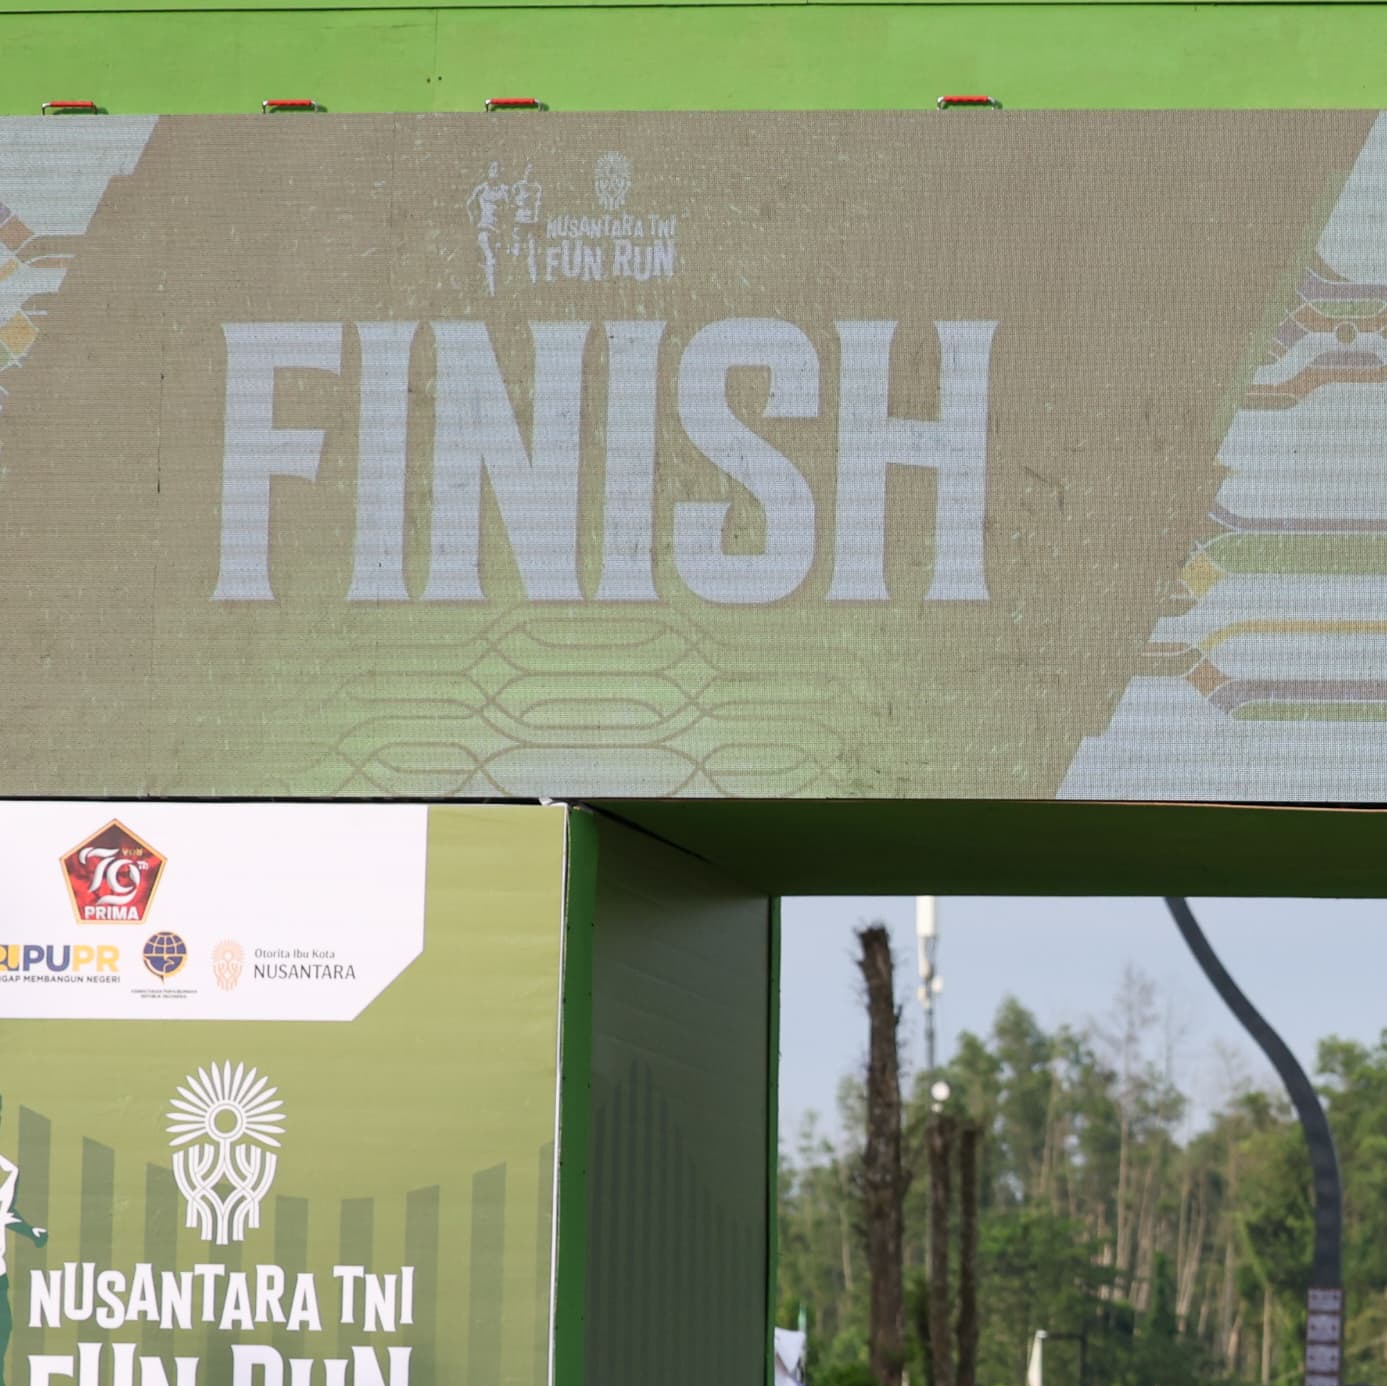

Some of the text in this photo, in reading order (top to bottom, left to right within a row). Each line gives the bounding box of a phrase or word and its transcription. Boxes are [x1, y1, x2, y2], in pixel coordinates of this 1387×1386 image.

[546, 213, 643, 239] NUSANTARA
[545, 239, 676, 282] FUN RUN
[209, 317, 999, 603] FINISH
[79, 847, 141, 906] 79
[84, 905, 140, 920] PRIMA
[22, 944, 121, 973] PUPR
[254, 948, 336, 960] Otorita Ibu Kota
[0, 975, 121, 984] GAP MEMBANGUN NEGERI
[253, 964, 356, 980] NUSANTARA
[28, 1262, 415, 1332] NUSANTARA TNI
